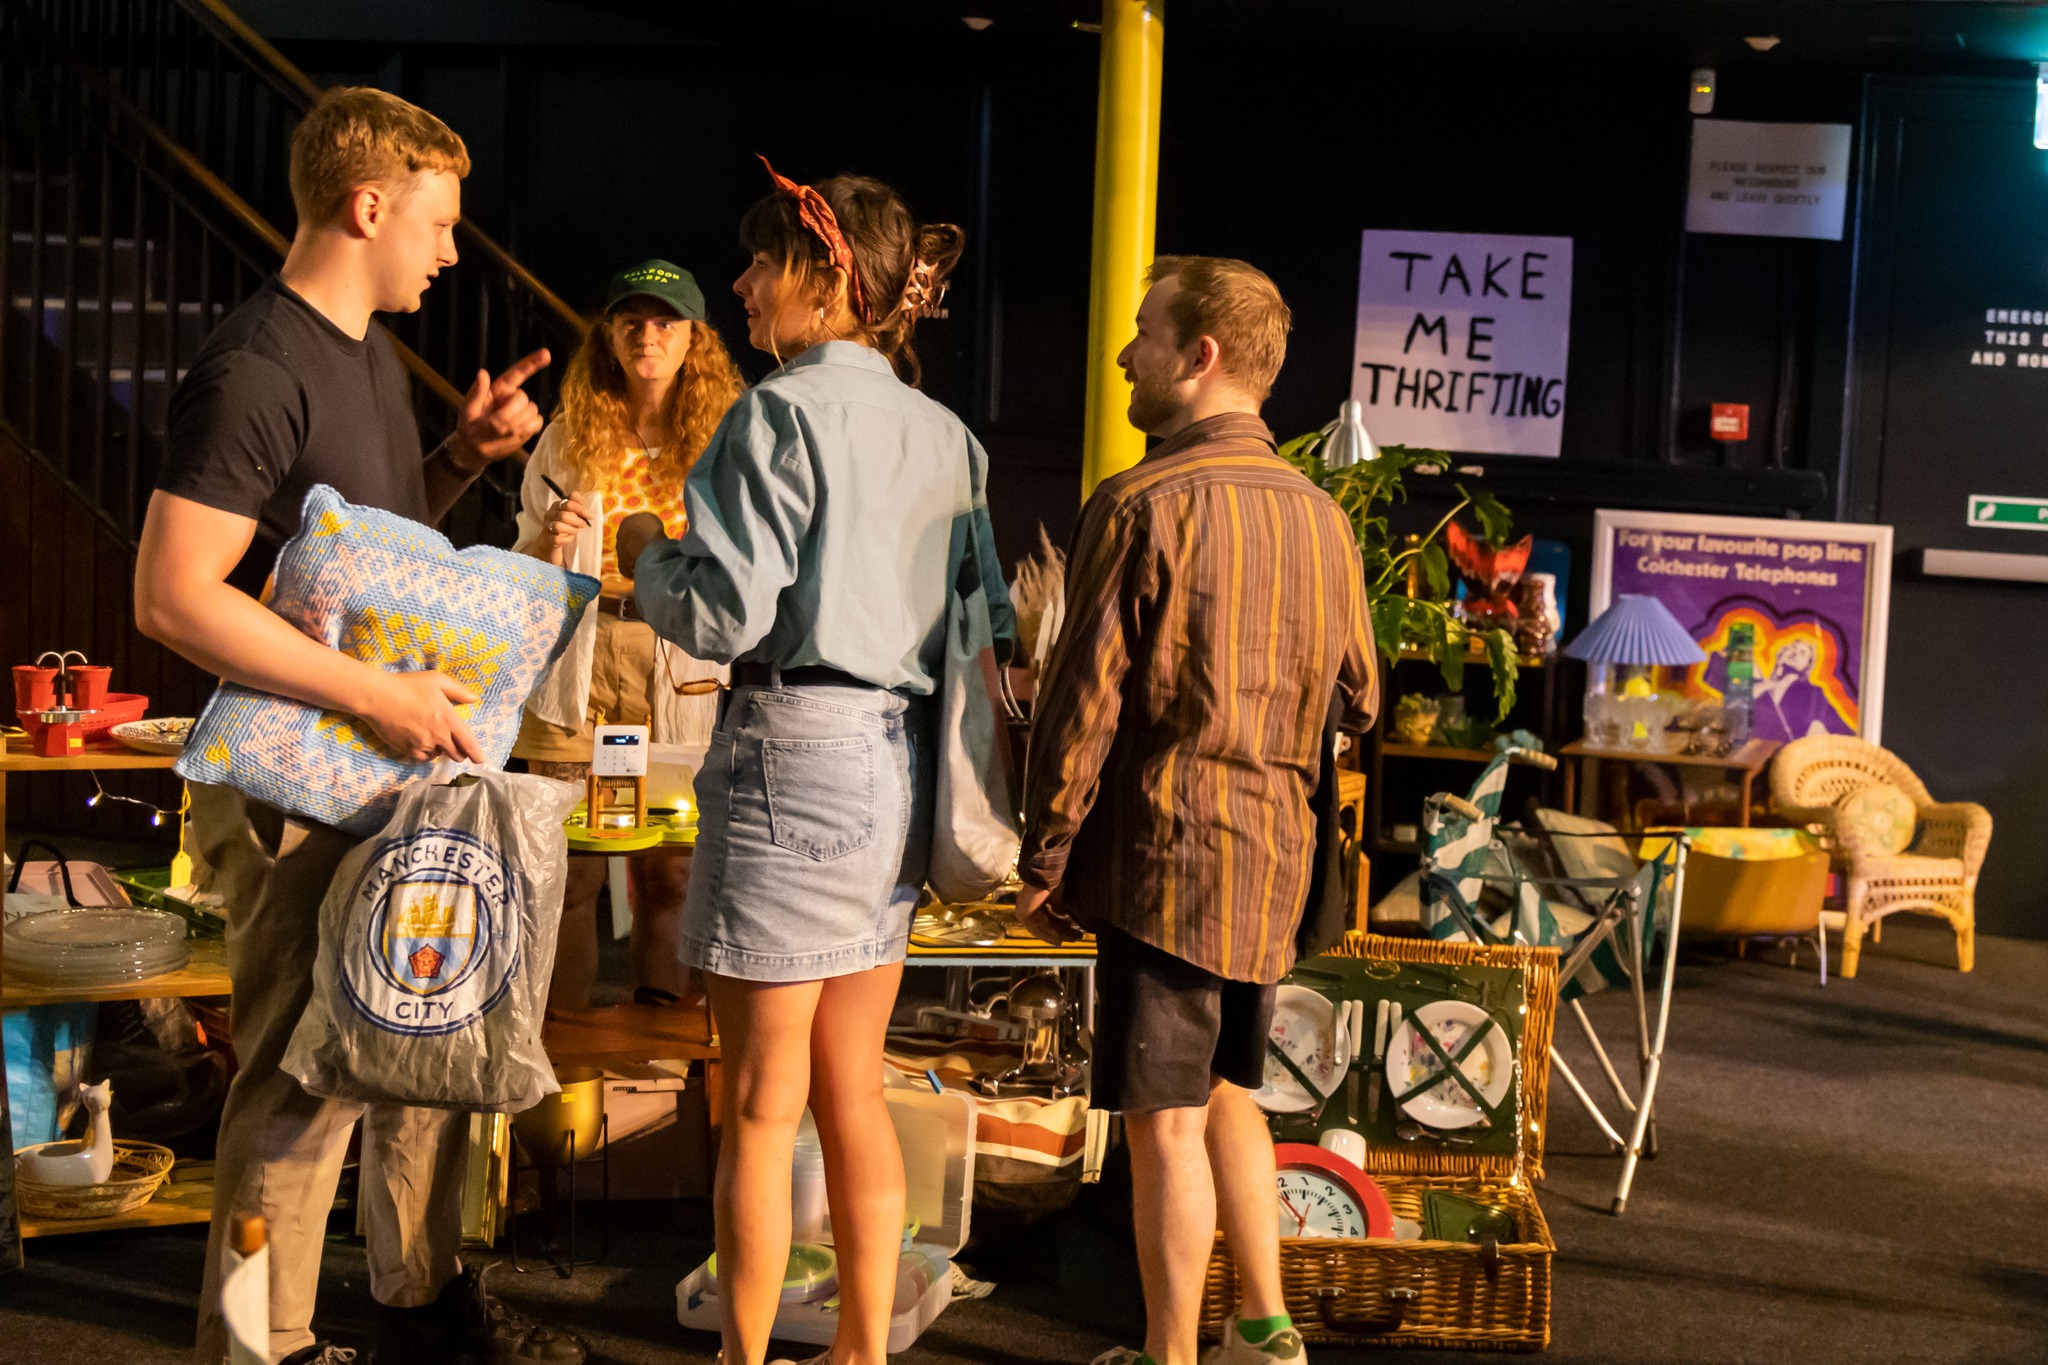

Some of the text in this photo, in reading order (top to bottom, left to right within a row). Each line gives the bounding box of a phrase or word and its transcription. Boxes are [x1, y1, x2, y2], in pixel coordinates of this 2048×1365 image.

[1388, 251, 1549, 300] TAKE
[1403, 312, 1496, 361] ME
[1984, 329, 2031, 347] THIS
[1970, 350, 2007, 367] AND
[1360, 361, 1564, 419] THRIFTING
[1618, 529, 1862, 563] For your favourite pop line
[1636, 556, 1838, 586] Colchester Telephones
[362, 844, 509, 908] MANCHESTER
[395, 1001, 454, 1019] CITY
[1300, 1176, 1309, 1186] 1
[1325, 1185, 1336, 1197] 2
[1342, 1204, 1353, 1215] 3
